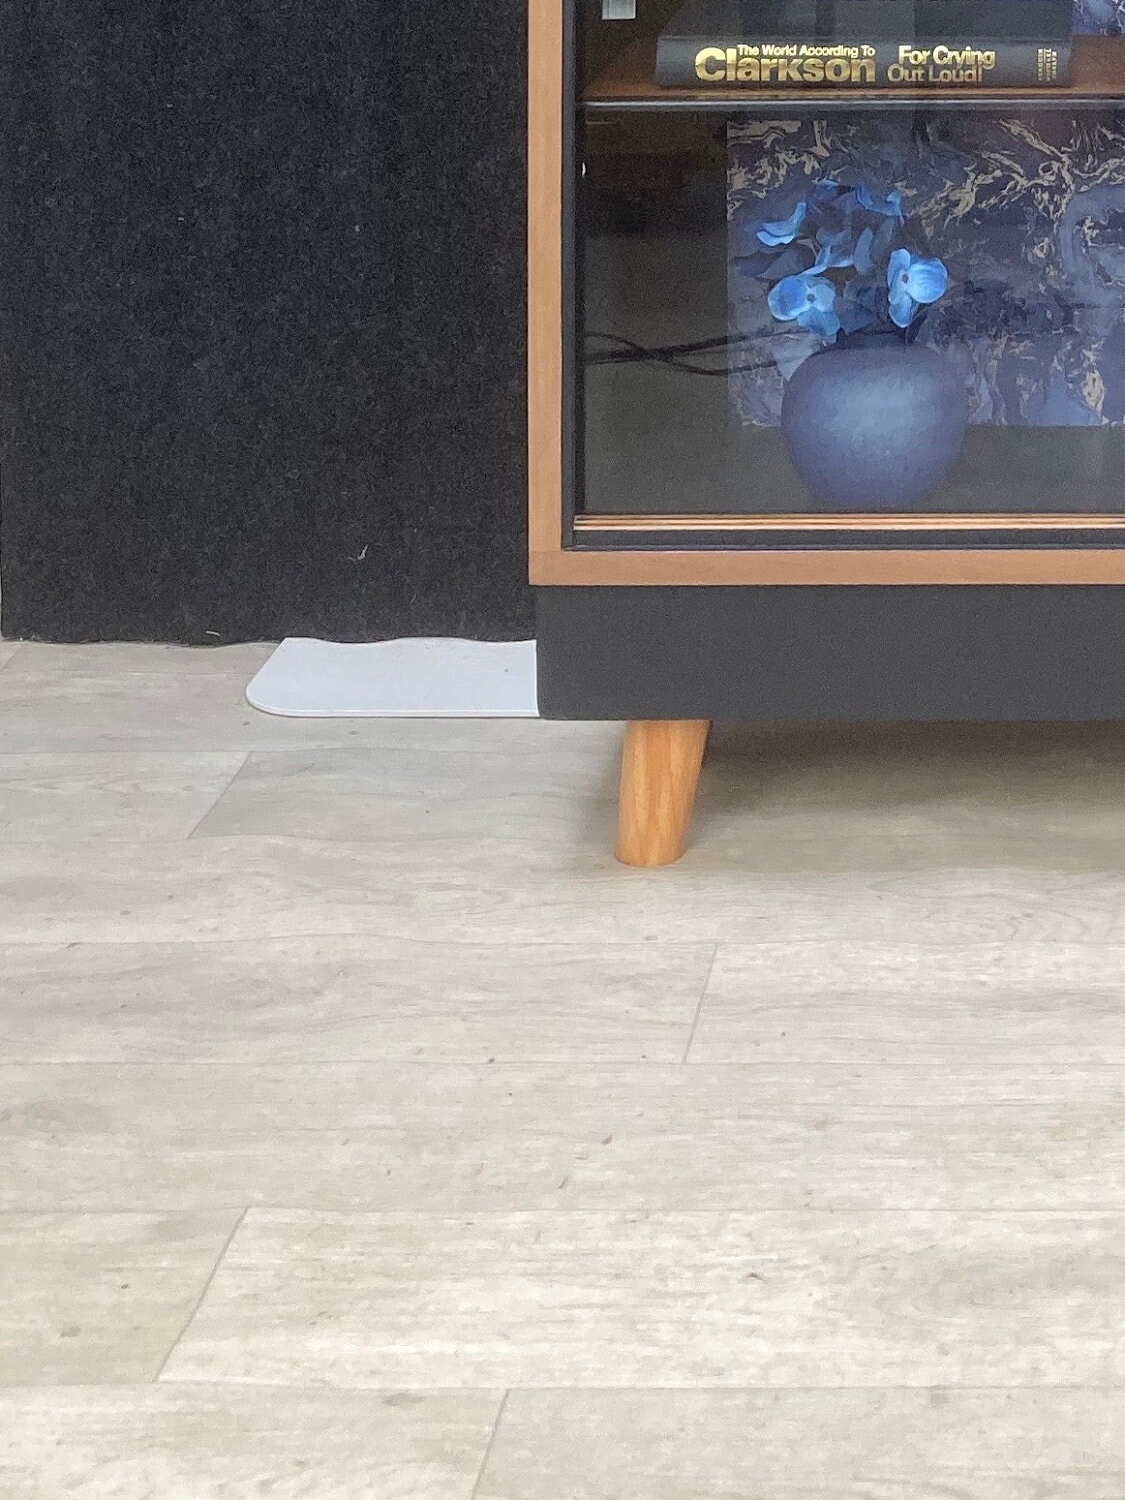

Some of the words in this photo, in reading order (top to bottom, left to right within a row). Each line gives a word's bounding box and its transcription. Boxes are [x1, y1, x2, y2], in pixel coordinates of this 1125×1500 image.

[737, 44, 760, 56] The
[761, 44, 798, 56] World
[799, 44, 859, 59] According
[860, 44, 876, 57] To
[898, 45, 932, 66] For
[932, 45, 996, 70] Crying
[694, 47, 876, 83] Clarkson
[887, 63, 925, 83] Out
